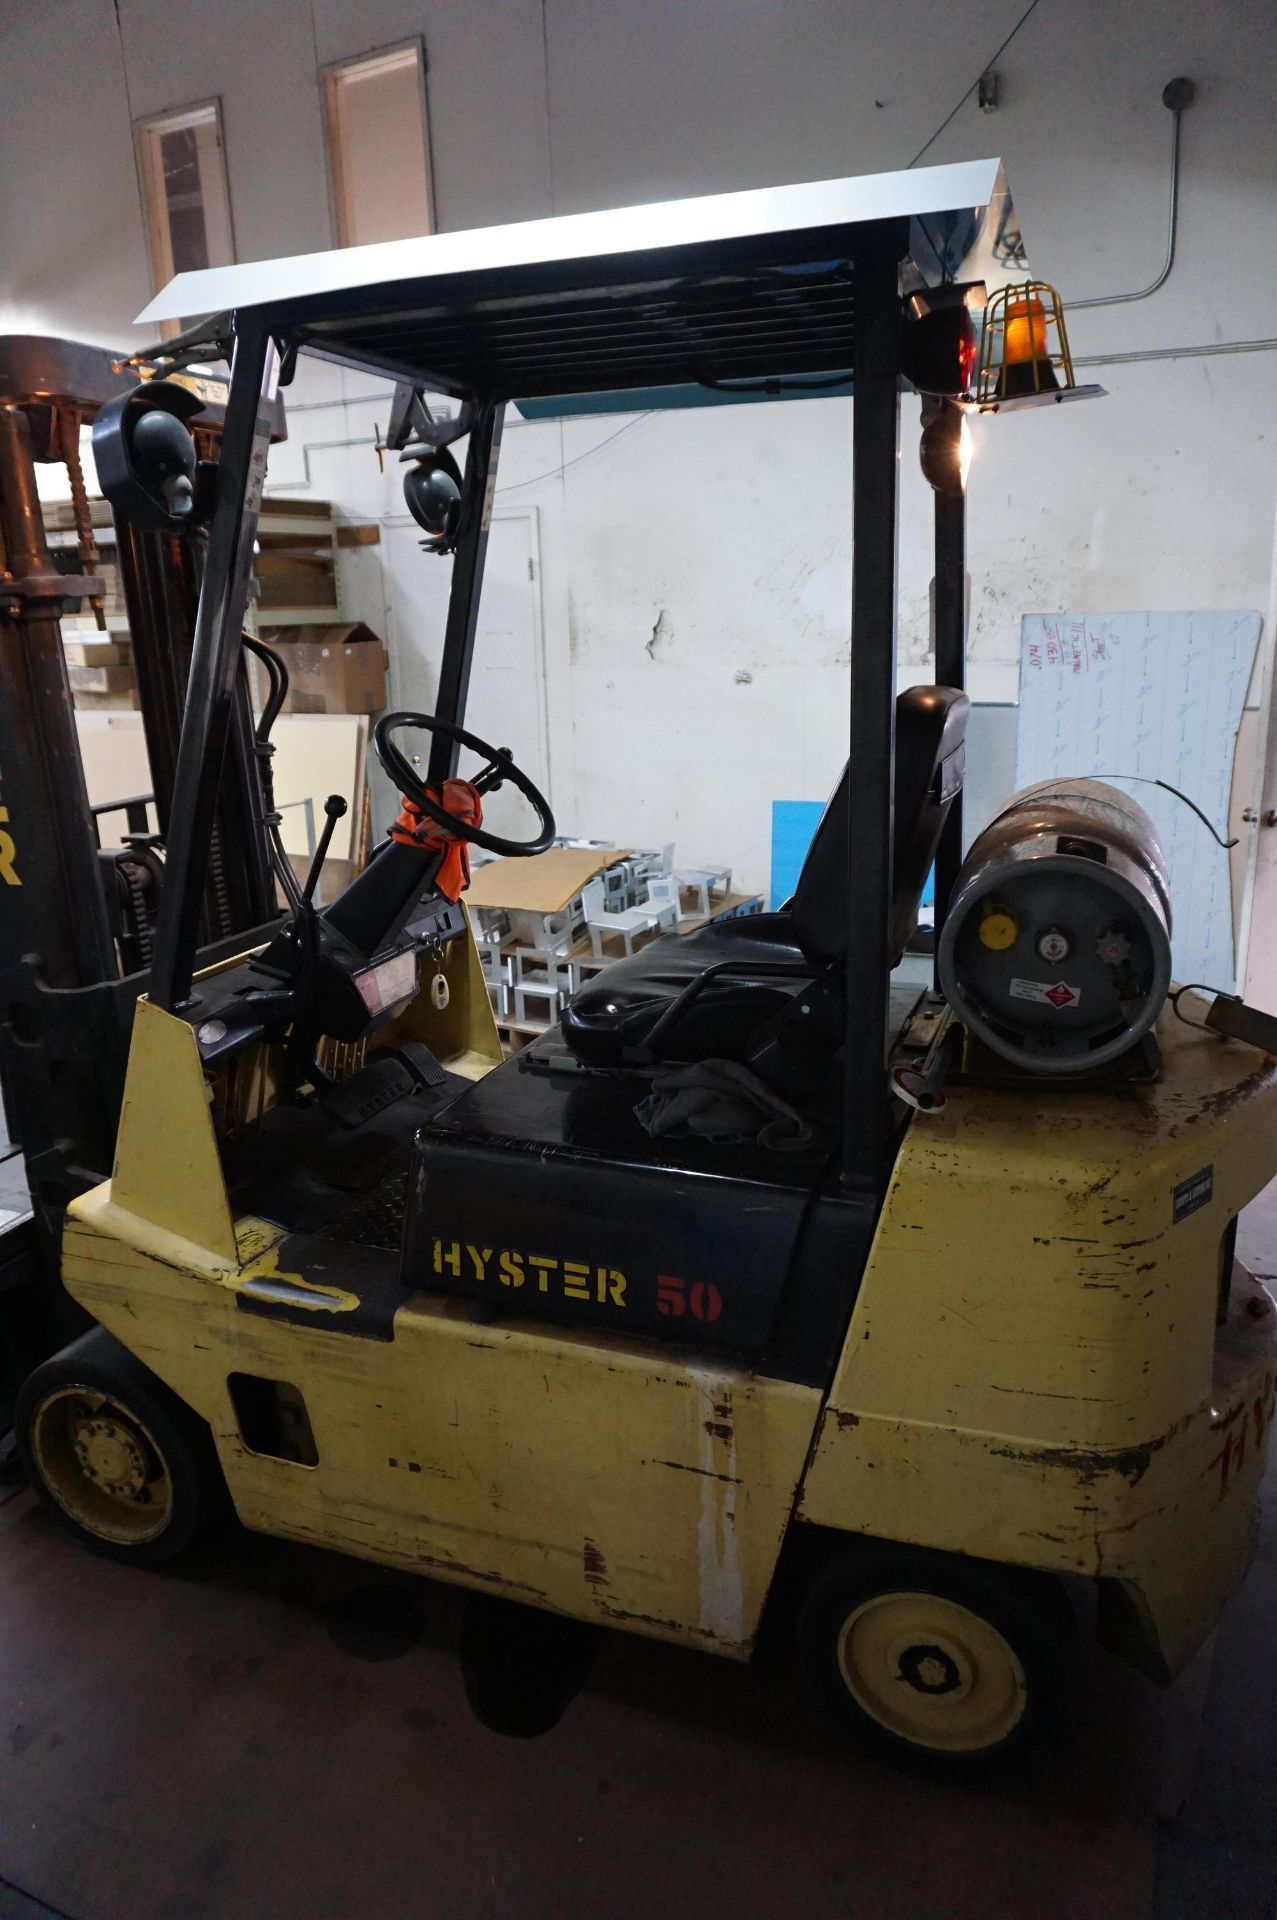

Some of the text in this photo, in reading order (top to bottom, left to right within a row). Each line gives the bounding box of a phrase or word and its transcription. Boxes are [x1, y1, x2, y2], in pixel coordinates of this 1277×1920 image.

[1046, 640, 1058, 664] 430
[357, 1081, 407, 1119] HYSTER
[433, 1238, 722, 1323] HYSTER 50
